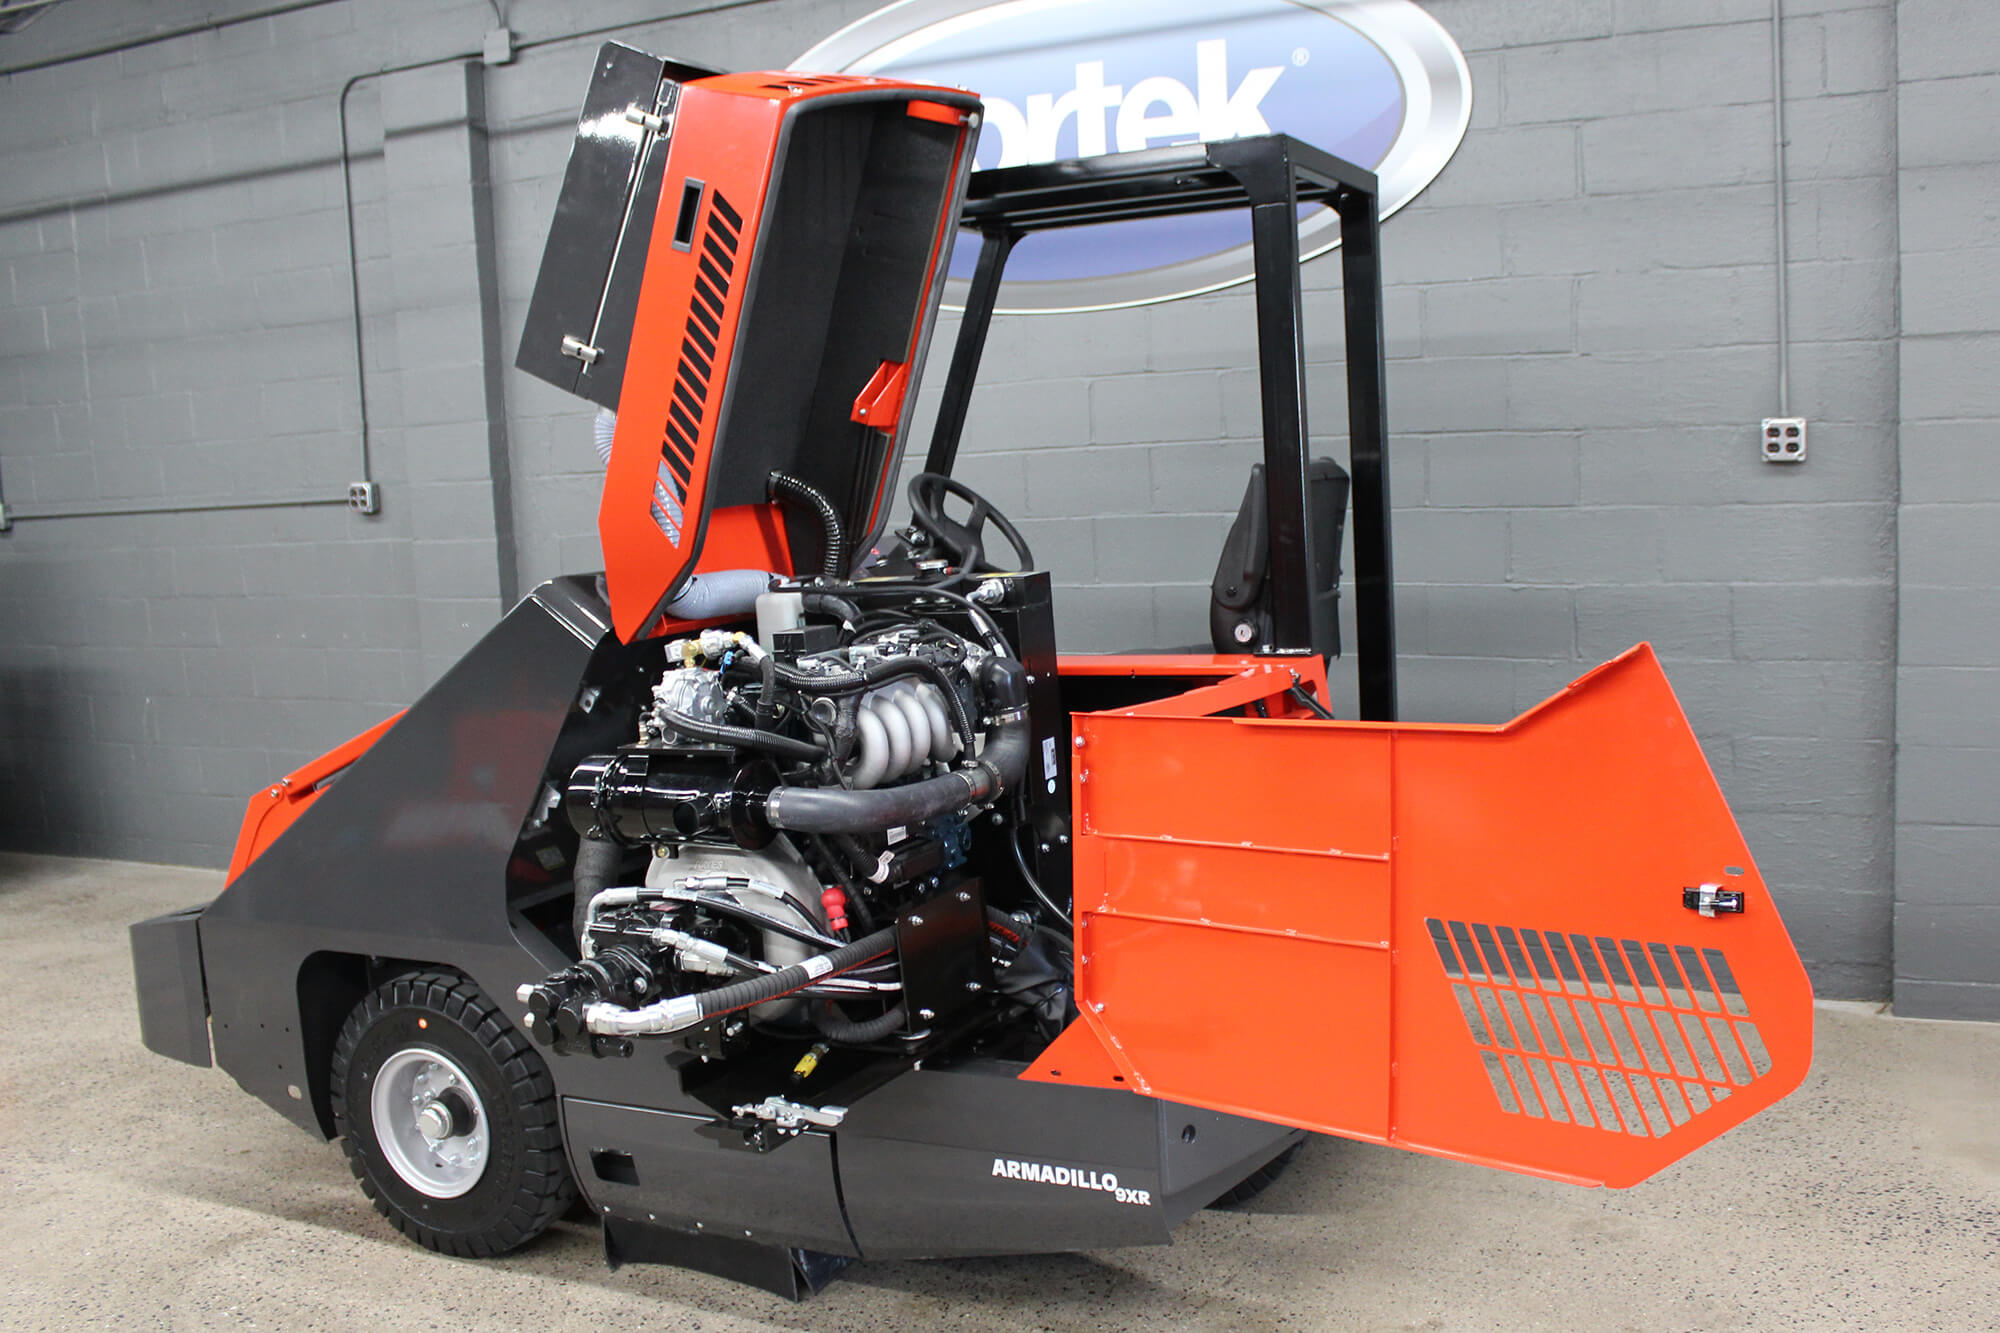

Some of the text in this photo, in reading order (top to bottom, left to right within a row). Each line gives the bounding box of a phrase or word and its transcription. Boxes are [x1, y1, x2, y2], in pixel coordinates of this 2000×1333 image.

[970, 38, 1286, 173] ortek
[991, 1158, 1151, 1206] ARMADILLO 9XR
